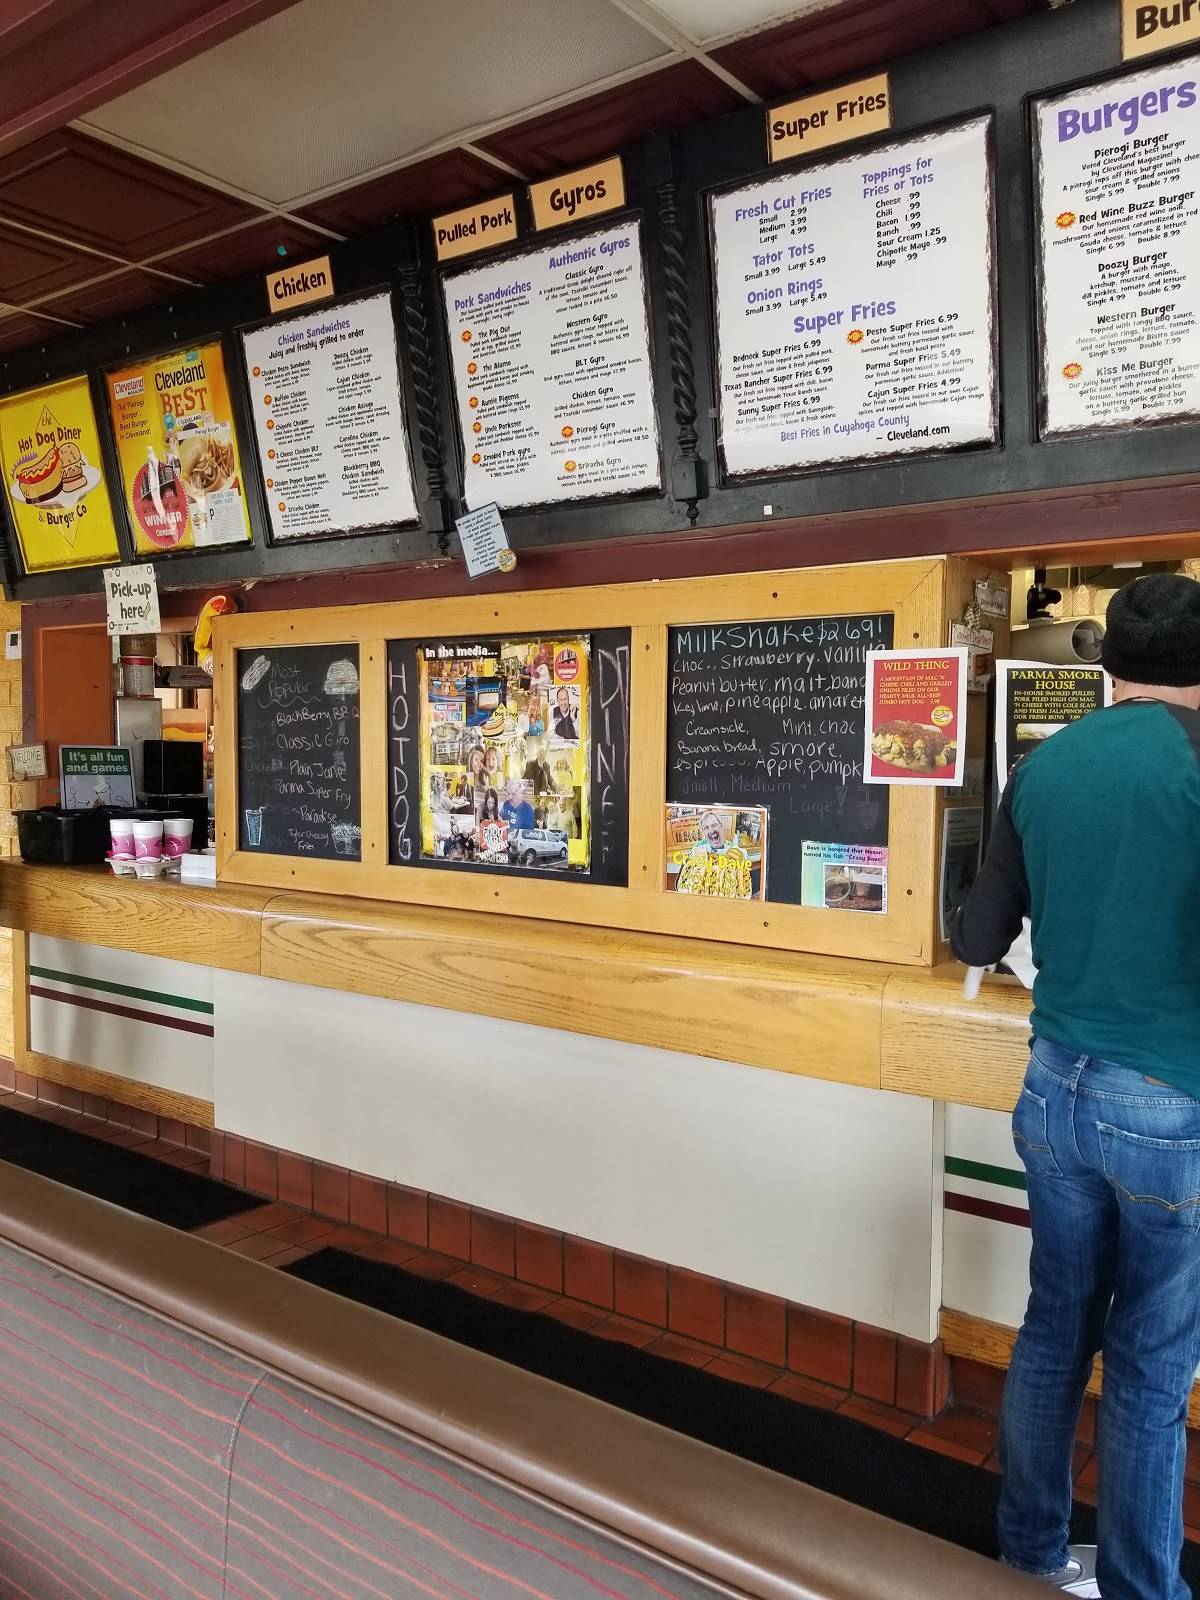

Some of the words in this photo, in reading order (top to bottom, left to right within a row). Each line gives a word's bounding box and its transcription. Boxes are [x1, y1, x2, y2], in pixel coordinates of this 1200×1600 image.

[773, 109, 828, 140] Super
[837, 93, 886, 121] Fries
[1058, 81, 1196, 142] Burgers
[1082, 161, 1100, 171] Voted
[1103, 151, 1141, 166] Cleveland's
[1144, 147, 1159, 155] best
[1162, 140, 1186, 151] burger
[1094, 142, 1129, 159] Pierogi
[1134, 133, 1169, 149] Burger
[862, 163, 912, 185] Toppings
[916, 156, 933, 170] for
[1102, 161, 1134, 174] Cleveland
[1137, 151, 1173, 166] Magazine!
[549, 180, 607, 215] Gyros
[863, 183, 890, 198] Fries
[894, 180, 906, 191] or
[910, 174, 934, 186] Tots
[1085, 194, 1105, 202] Single
[1108, 188, 1125, 197] 5.99
[1137, 179, 1160, 190] Double
[1163, 175, 1180, 184] 7.99
[735, 202, 768, 222] Fresh
[774, 195, 796, 212] Cut
[801, 186, 832, 206] Fries
[1079, 211, 1096, 224] Red
[1101, 206, 1125, 219] Wine
[1129, 200, 1155, 213] Buzz
[1159, 191, 1195, 207] Burger
[438, 218, 477, 245] Pulled
[481, 208, 512, 232] Pork
[759, 214, 778, 225] Small
[790, 207, 807, 217] 2.99
[760, 222, 786, 234] Medium
[790, 216, 807, 226] 3.99
[760, 234, 778, 244] Large
[790, 226, 807, 236] 4.99
[877, 237, 895, 248] Sour
[898, 230, 922, 244] Cream
[925, 227, 941, 238] 1.25
[549, 247, 596, 269] Authentic
[600, 238, 630, 256] Gyros
[753, 252, 783, 268] Tator
[788, 244, 814, 258] Tots
[1098, 259, 1129, 272] Doozy
[1133, 251, 1167, 266] Burger
[565, 269, 586, 280] Classic
[589, 265, 603, 275] Gyro
[274, 271, 326, 299] Chicken
[455, 296, 474, 310] Pork
[478, 281, 531, 304] Sandwiches
[748, 288, 782, 304] Onion
[788, 279, 823, 295] Rings
[746, 306, 764, 316] Small
[766, 303, 782, 311] 3.99
[790, 298, 808, 306] Large
[811, 292, 827, 301] 5.49
[1097, 310, 1137, 324] Western
[1141, 303, 1176, 318] Burger
[567, 317, 590, 328] Western
[593, 314, 608, 323] Gyro
[794, 310, 844, 334] Super
[852, 301, 896, 322] Fries
[867, 328, 887, 336] Pesto
[890, 324, 912, 332] Super
[916, 318, 935, 327] Fries
[938, 313, 958, 322] 6.99
[278, 331, 304, 346] Chicken
[307, 319, 350, 337] Sandwiches
[269, 349, 283, 360] Juicy
[286, 344, 295, 354] and
[297, 340, 317, 352] freshly
[319, 335, 338, 348] grilled
[340, 332, 346, 341] to
[348, 329, 364, 338] order
[733, 351, 759, 363] Redneck
[762, 348, 781, 358] Super
[784, 344, 800, 353] Fries
[804, 340, 821, 349] 6.99
[155, 361, 206, 391] Cleveland
[1096, 368, 1117, 376] Kiss
[1122, 363, 1135, 372] Me
[1140, 356, 1174, 371] Burger
[114, 379, 144, 394] Cleveland
[572, 390, 596, 400] Chicken
[599, 387, 613, 396] Gyro
[868, 389, 890, 399] Cajun
[893, 385, 915, 394] Super
[919, 381, 938, 390] Fries
[941, 378, 961, 386] 4.99
[160, 387, 207, 417] BEST
[42, 411, 52, 427] the
[781, 432, 798, 442] Best
[801, 429, 820, 438] Fries
[823, 426, 830, 434] in
[833, 419, 875, 436] Cuyahoga
[878, 415, 910, 426] County
[18, 436, 32, 453] Hot
[36, 431, 55, 450] Dog
[58, 426, 81, 440] Diner
[887, 425, 950, 441] Cleveland.com
[39, 511, 45, 522] &
[47, 510, 75, 528] Burger
[77, 505, 87, 517] Co
[111, 581, 152, 599] Pick-up
[120, 602, 144, 619] here
[426, 648, 435, 658] In
[438, 645, 454, 657] the
[883, 662, 911, 671] WILD
[914, 661, 950, 669] THING
[1012, 671, 1054, 679] PARMA
[1059, 671, 1100, 679] SMOKE
[1035, 681, 1075, 689] HOUSE
[66, 763, 88, 772] and
[92, 765, 128, 773] games
[69, 752, 86, 761] It's
[90, 752, 103, 761] all
[107, 753, 124, 761] fun
